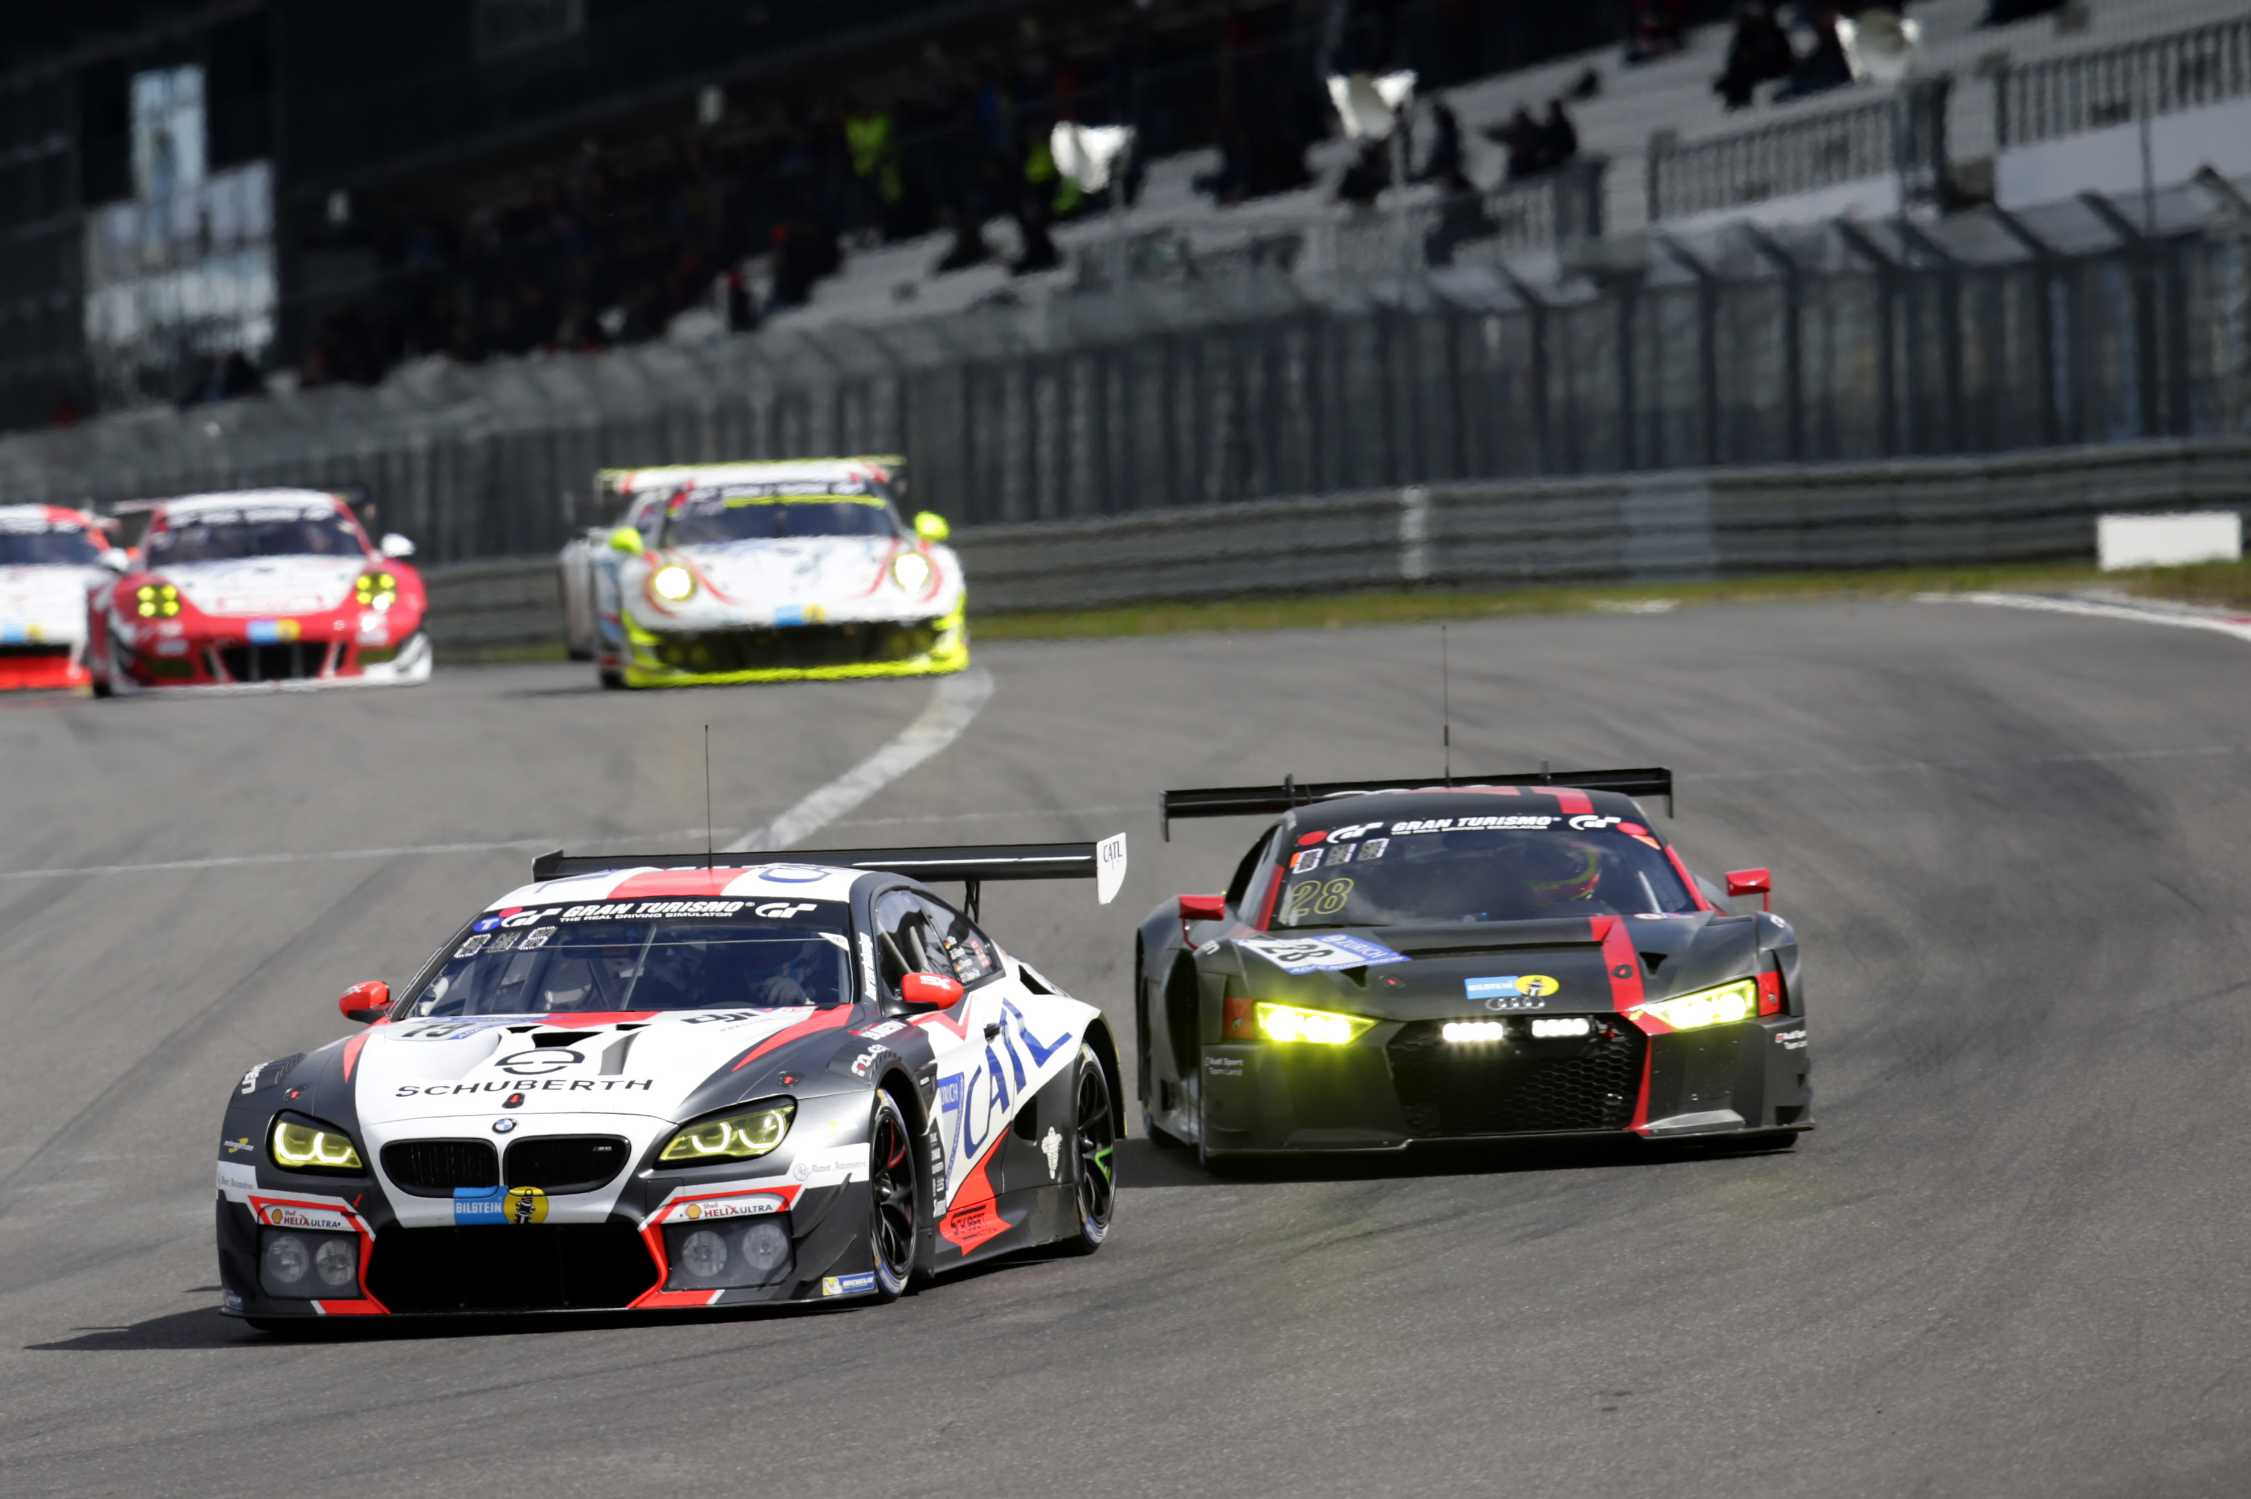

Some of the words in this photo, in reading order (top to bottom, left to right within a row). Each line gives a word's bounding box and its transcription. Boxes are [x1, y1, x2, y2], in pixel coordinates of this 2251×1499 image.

[1391, 818, 1453, 833] GRAN
[1457, 815, 1552, 828] TURISMO
[1291, 877, 1355, 918] 28
[562, 903, 632, 918] GRAN
[637, 901, 744, 914] TURISMO
[395, 1079, 654, 1097] SCHUBERTH
[455, 1202, 502, 1214] BILSTEIN
[704, 1205, 738, 1217] HELIX
[738, 1205, 773, 1214] ULTRA
[284, 1215, 310, 1226] HELIX
[311, 1218, 339, 1228] ULTRA
